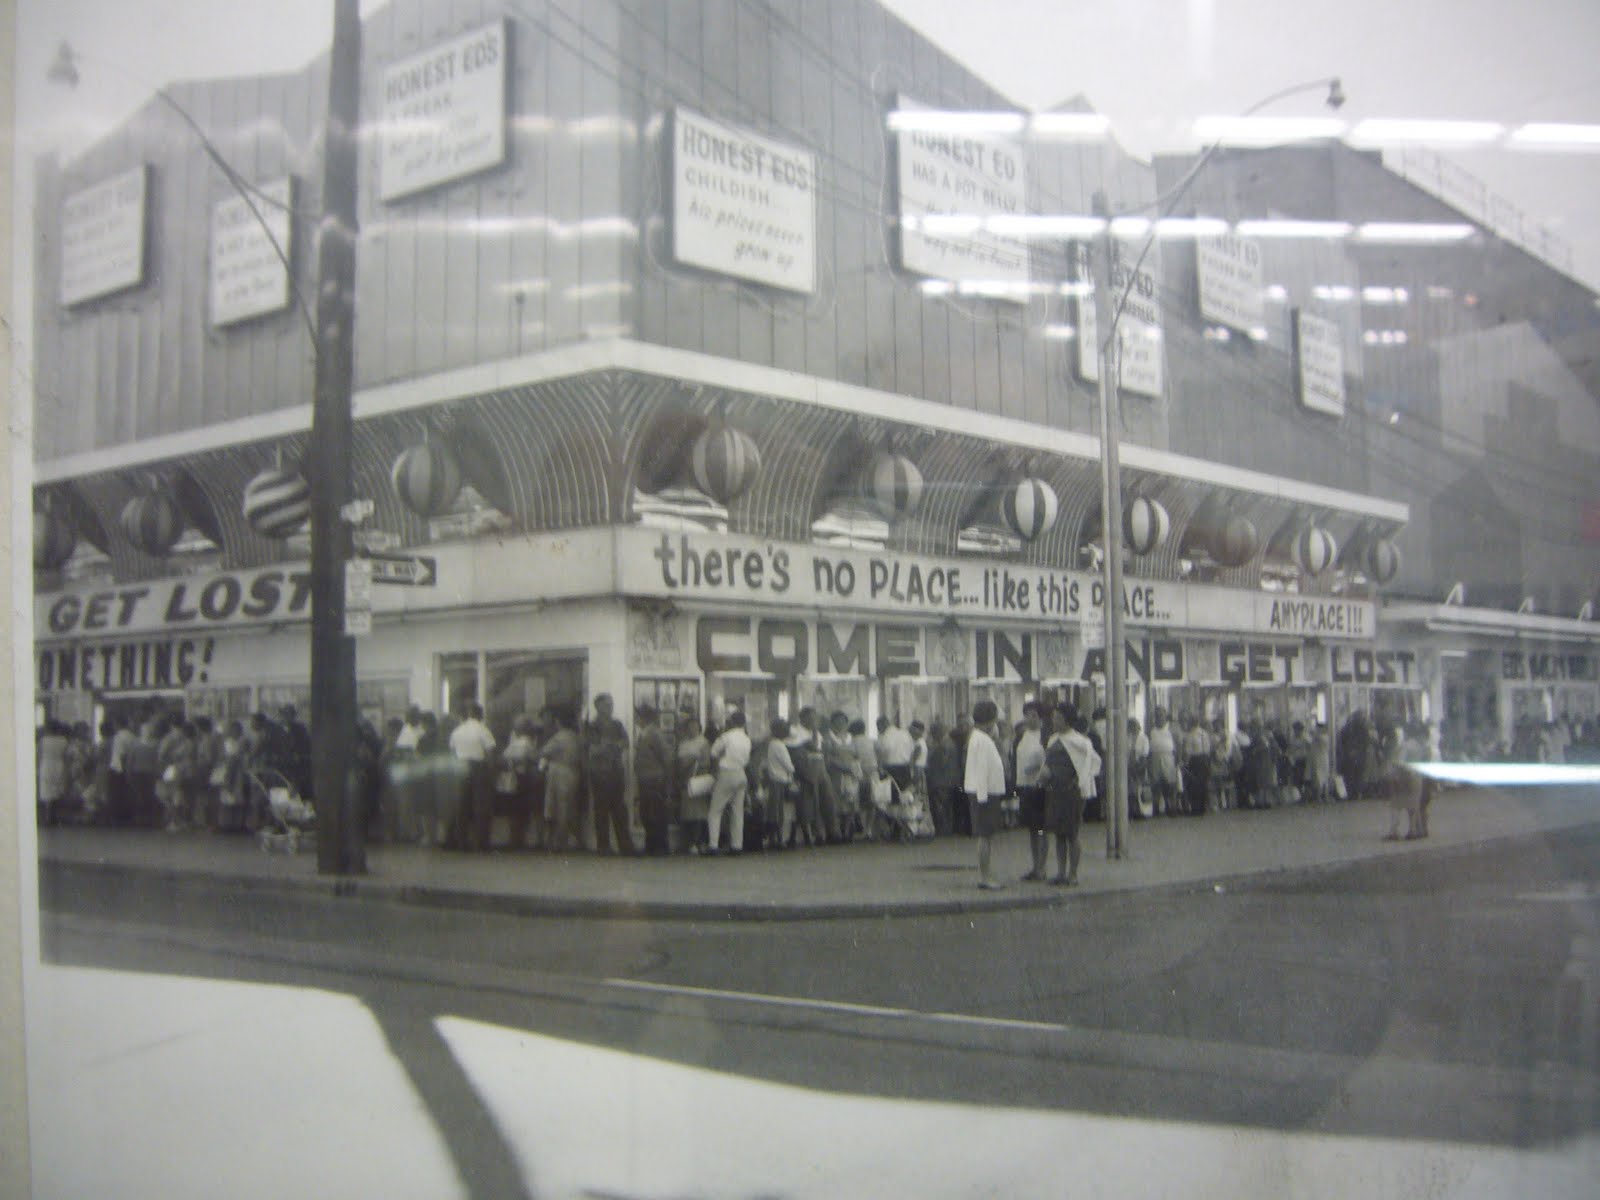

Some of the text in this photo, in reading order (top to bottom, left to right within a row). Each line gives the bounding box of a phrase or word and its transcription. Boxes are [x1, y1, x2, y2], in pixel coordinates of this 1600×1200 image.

[385, 51, 456, 104] HONEST
[683, 122, 765, 179] HONEST
[913, 159, 937, 185] HAS
[942, 170, 951, 190] A
[993, 148, 1015, 181] ED
[734, 240, 769, 262] grow
[653, 533, 791, 593] there's
[812, 555, 856, 597] no
[983, 567, 1030, 611] like
[1036, 574, 1080, 615] this
[49, 588, 148, 634] GET
[164, 570, 312, 624] LOST
[697, 615, 921, 677] COME
[975, 628, 1032, 682] IN
[1219, 641, 1300, 683] GET
[1330, 649, 1416, 683] LOST
